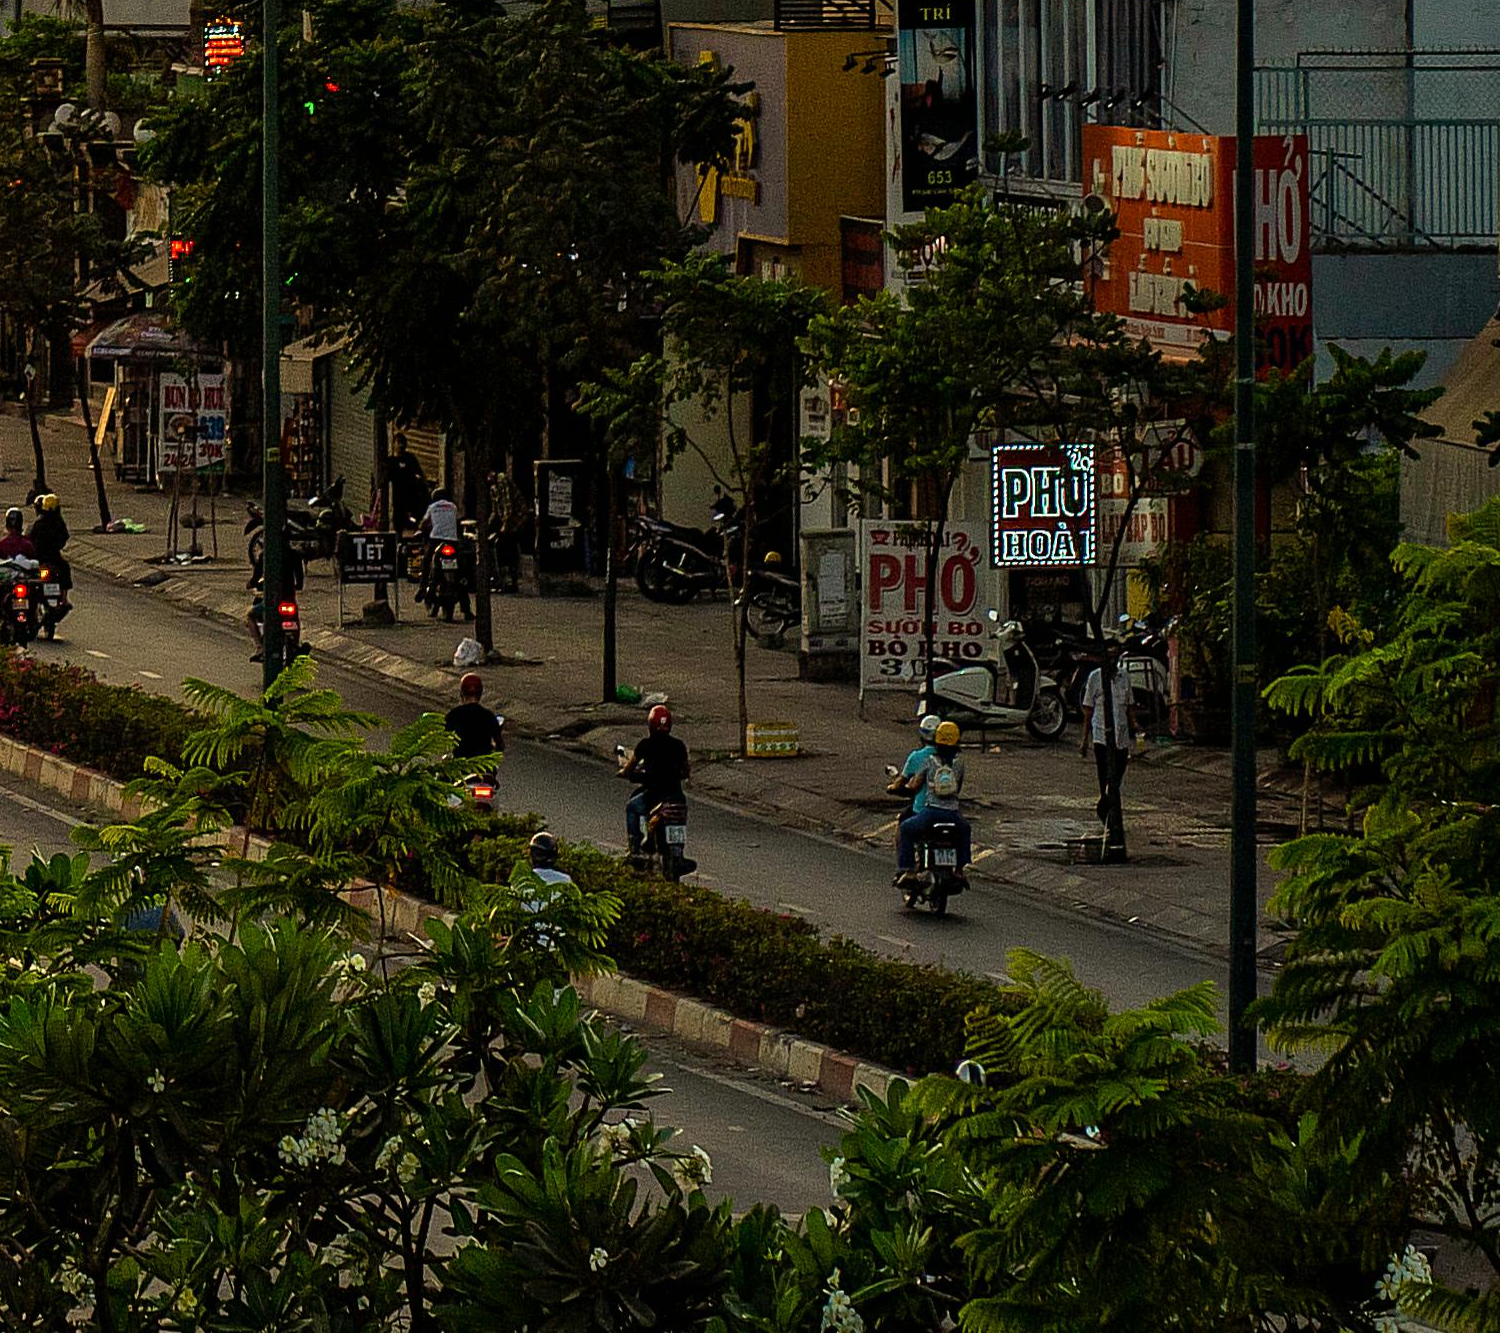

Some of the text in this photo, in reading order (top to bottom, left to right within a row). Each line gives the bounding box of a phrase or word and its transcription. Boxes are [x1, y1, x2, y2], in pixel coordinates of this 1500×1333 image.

[920, 3, 951, 21] TRÍ
[928, 170, 952, 184] 653
[1267, 282, 1308, 318] KHO
